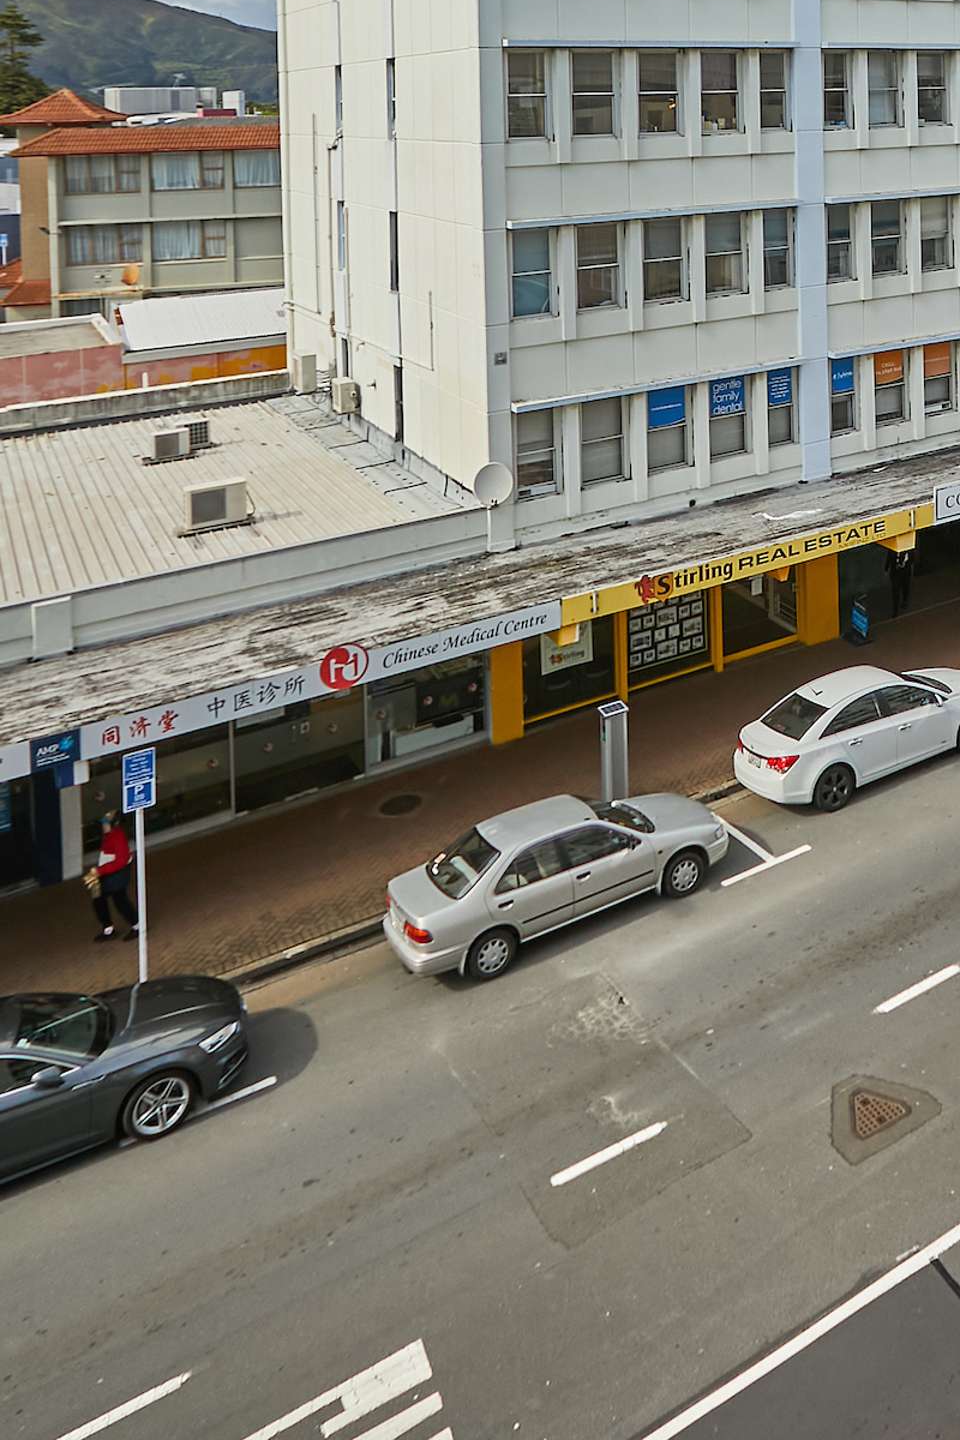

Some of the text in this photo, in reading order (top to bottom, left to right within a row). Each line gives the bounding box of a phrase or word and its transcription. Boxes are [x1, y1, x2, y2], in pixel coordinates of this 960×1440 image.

[712, 379, 742, 394] gentle
[712, 391, 740, 403] family
[712, 400, 743, 415] dental
[656, 563, 734, 596] Stirling
[738, 544, 800, 571] REAL
[804, 520, 886, 553] ESTATE
[383, 614, 548, 669] Chinese Medical Centre
[101, 675, 306, 747] 同济堂 中医诊所
